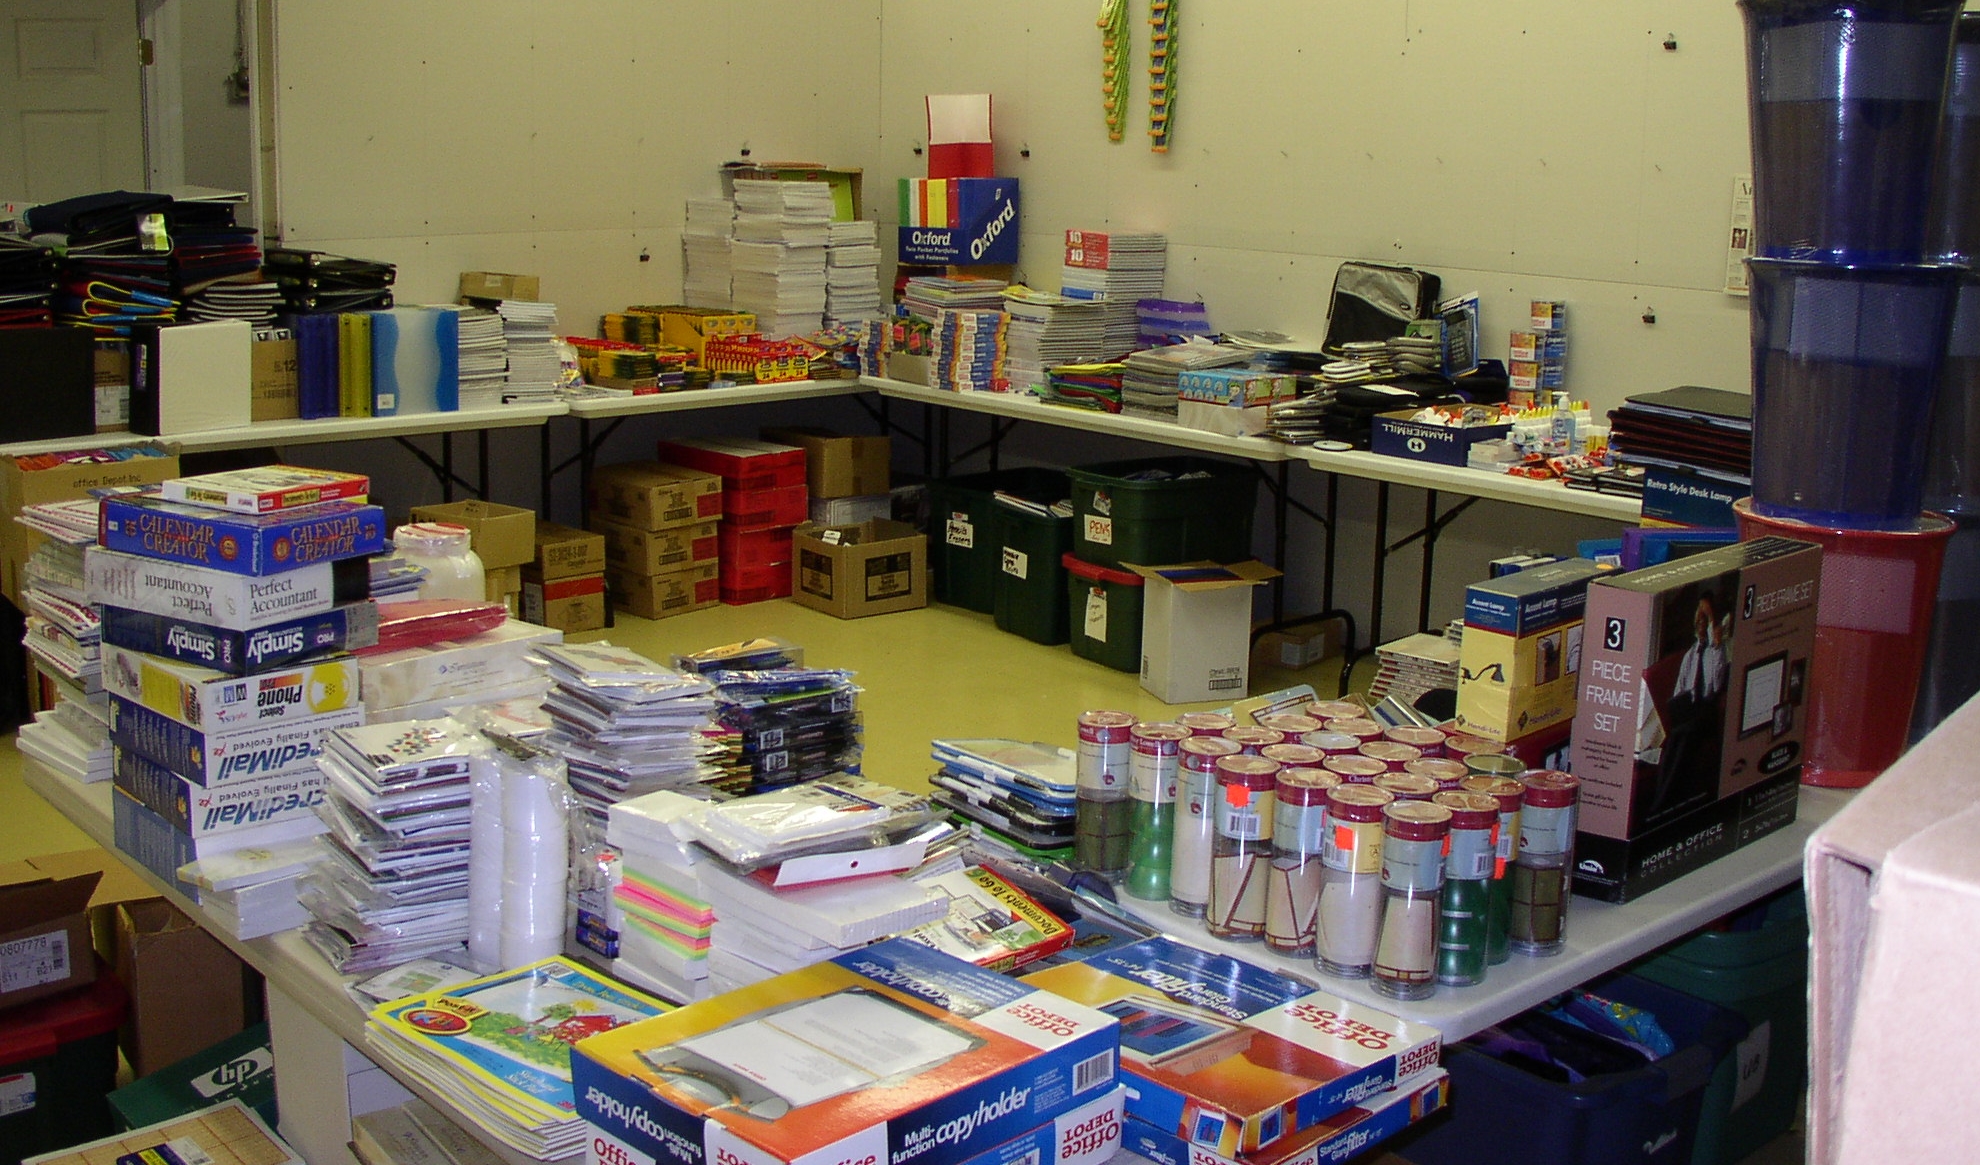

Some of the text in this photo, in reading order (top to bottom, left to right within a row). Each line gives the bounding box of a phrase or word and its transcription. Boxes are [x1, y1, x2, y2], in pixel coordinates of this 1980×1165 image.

[912, 231, 951, 246] Oxford
[970, 198, 1016, 260] Oxford
[1069, 230, 1082, 244] 10
[1070, 248, 1084, 262] 10
[1382, 423, 1454, 443] HAMMERMILL
[1647, 478, 1732, 504] Retro Style Desk Lamp
[139, 511, 216, 548] CALENDAR
[290, 515, 364, 545] CALENDAR
[143, 534, 211, 564] CREATOR
[296, 537, 355, 564] CREATOR
[144, 573, 214, 597] Accountant
[250, 577, 293, 599] Perfect
[173, 594, 213, 617] Perfect
[250, 587, 319, 615] Accountant
[167, 628, 216, 662] Simply
[247, 631, 305, 664] Simply
[317, 631, 335, 644] PRO
[1607, 620, 1622, 648] 3
[1592, 659, 1631, 684] PIECE
[257, 685, 303, 707] Phone
[1586, 685, 1632, 710] FRAME
[258, 705, 286, 719] Select
[1593, 713, 1620, 734] SET
[233, 737, 273, 752] Evolved
[276, 729, 310, 744] Finally
[219, 788, 260, 803] Evolved
[264, 781, 298, 795] Finally
[1641, 846, 1673, 869] HOME
[1686, 822, 1723, 846] OFFICE
[1641, 835, 1723, 878] COLLECTION
[979, 875, 995, 889] Go
[1002, 893, 1059, 936] Documents
[1018, 1002, 1081, 1030] DEPOT
[1172, 988, 1248, 1020] Standard
[1006, 1007, 1075, 1038] Office
[1282, 1004, 1390, 1051] Office
[1292, 1001, 1397, 1042] DEPOT
[1398, 1051, 1439, 1079] Office
[1399, 1040, 1438, 1067] DEPOT
[220, 1060, 250, 1083] hp
[585, 1085, 667, 1141] copyholder
[936, 1086, 1031, 1145] copyholder
[1064, 1108, 1115, 1142] DEPOT
[904, 1125, 936, 1147] Multi-
[1062, 1121, 1120, 1161] Office
[1319, 1136, 1348, 1158] Standard
[594, 1138, 638, 1165] Offi
[891, 1138, 936, 1165] function
